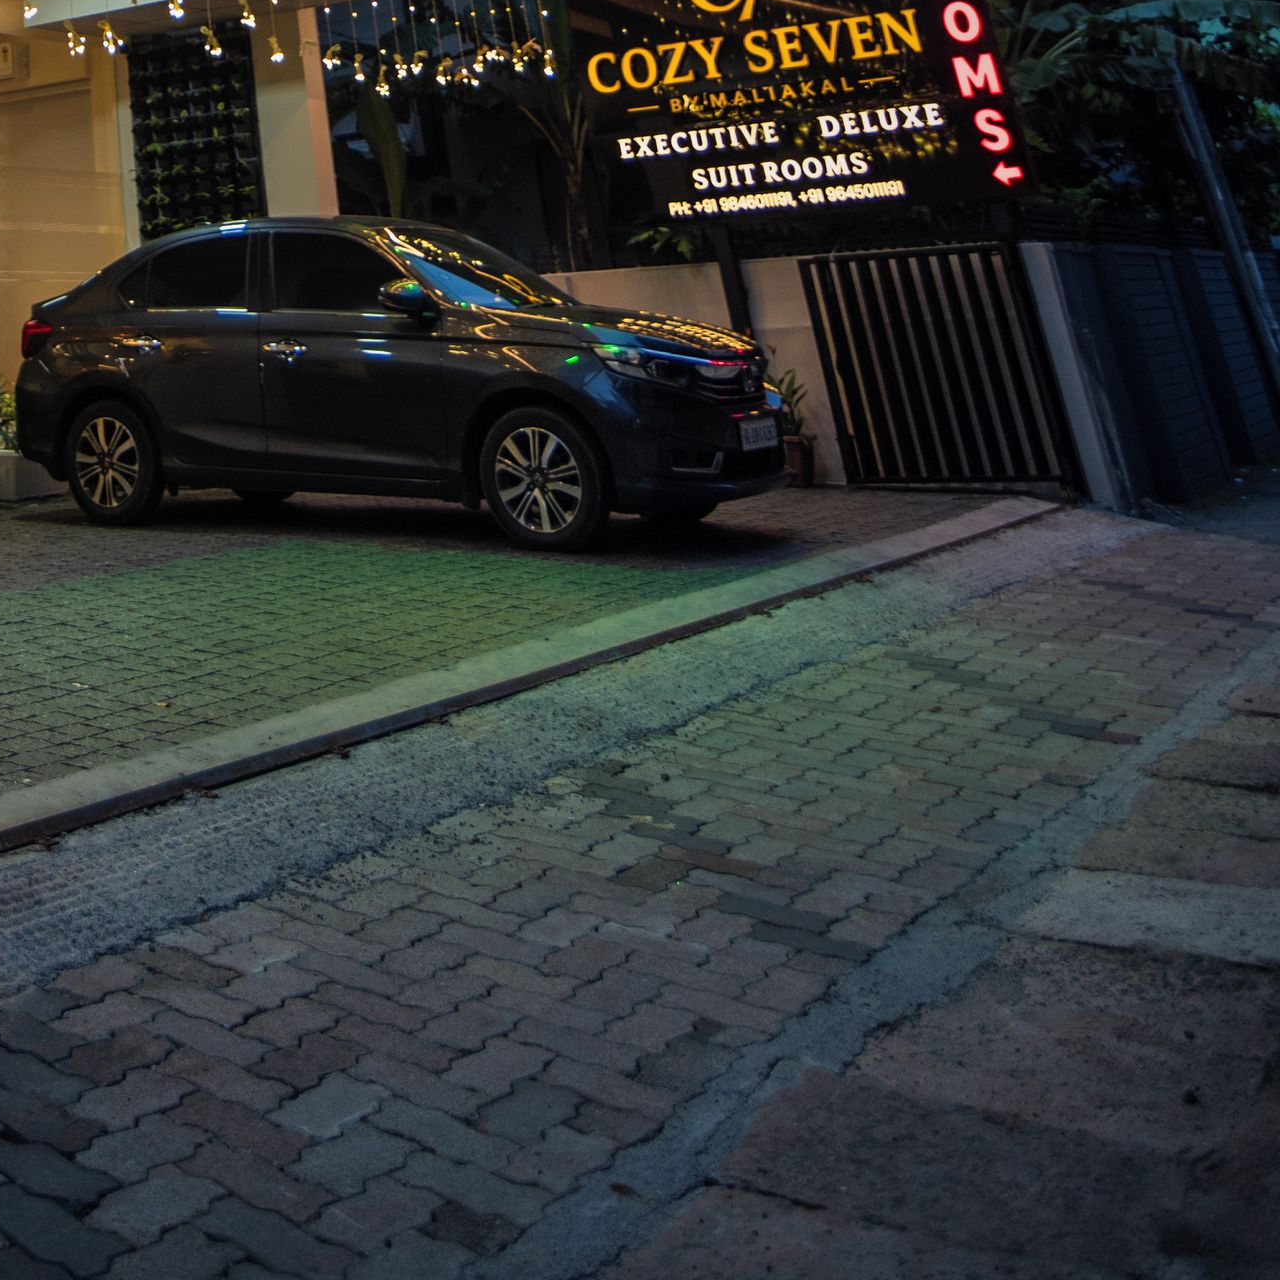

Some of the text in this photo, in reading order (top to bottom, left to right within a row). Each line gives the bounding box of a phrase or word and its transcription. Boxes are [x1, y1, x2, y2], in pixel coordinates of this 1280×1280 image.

[587, 8, 923, 94] COZY SEVEN
[617, 102, 944, 160] EXECUTIVE DELUXE
[692, 151, 869, 190] SUIT ROOMS
[694, 198, 718, 213] +91
[798, 188, 825, 204] +91
